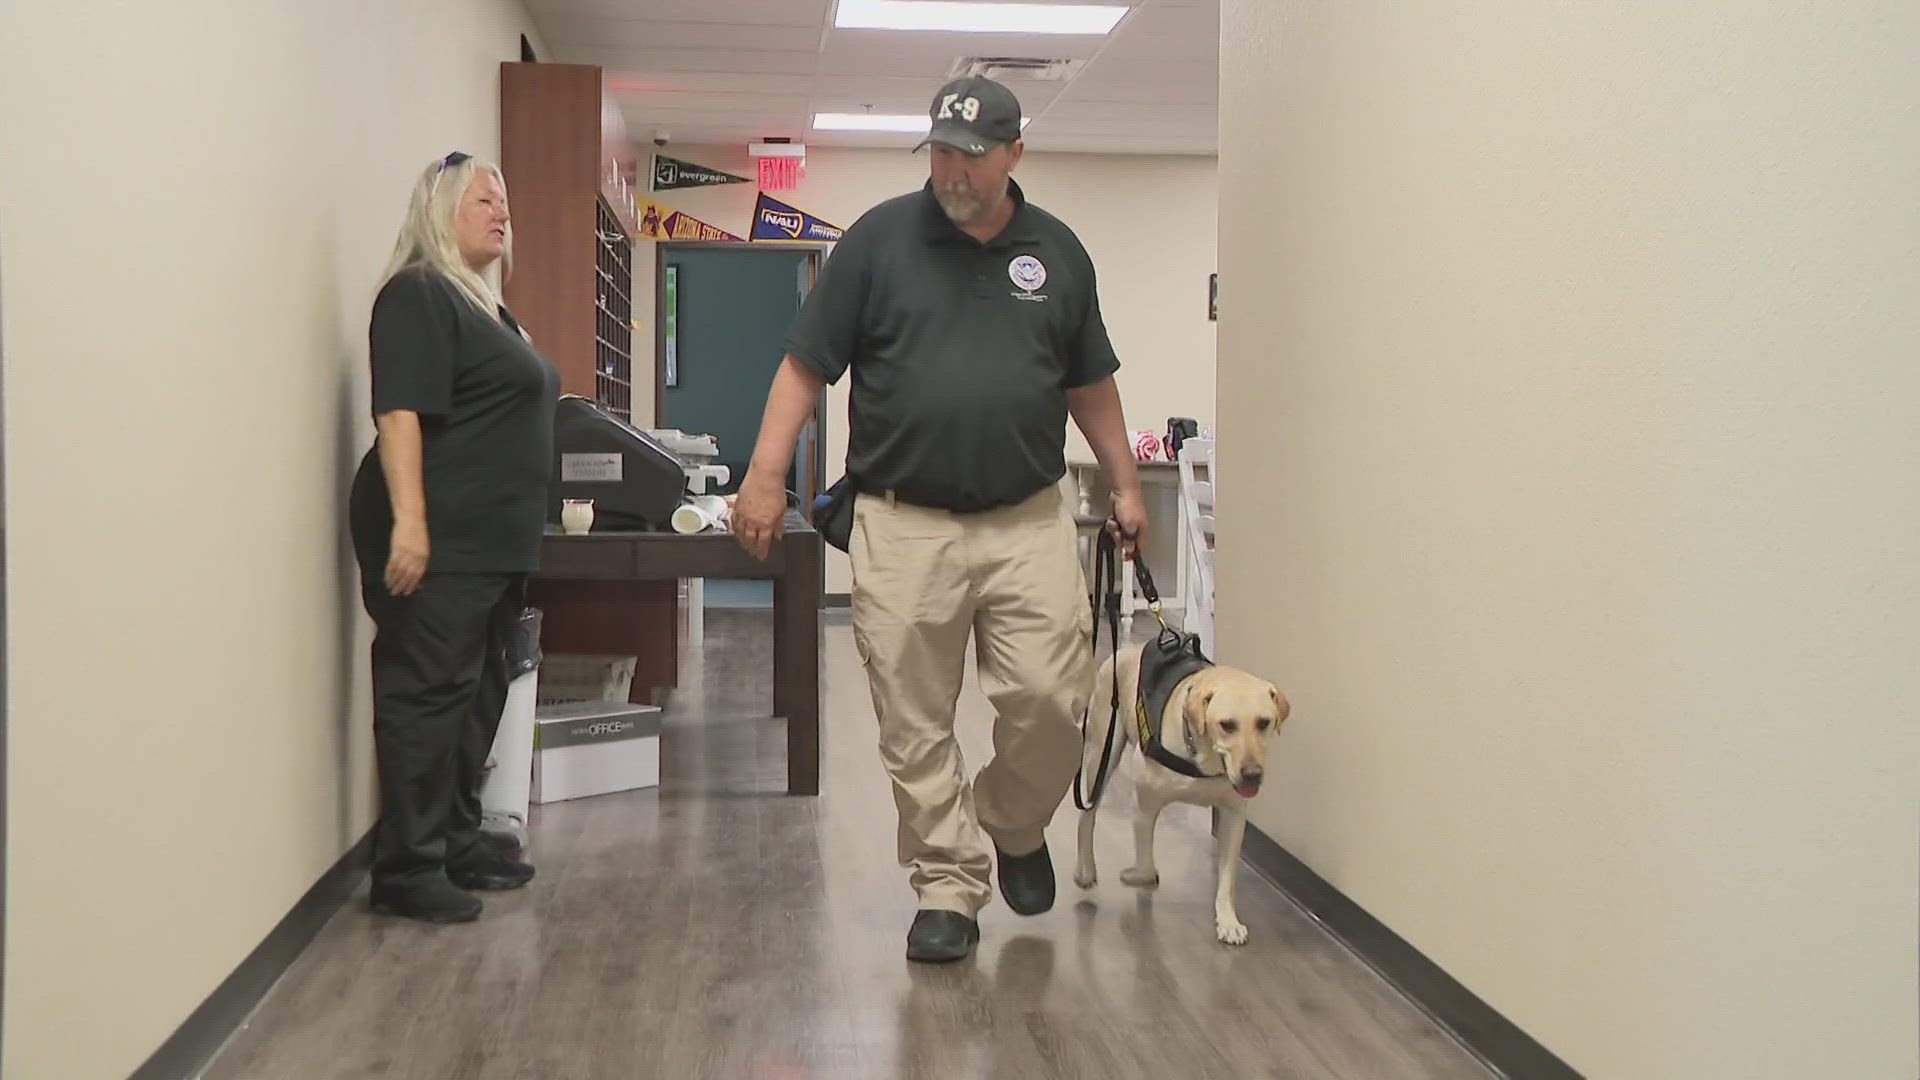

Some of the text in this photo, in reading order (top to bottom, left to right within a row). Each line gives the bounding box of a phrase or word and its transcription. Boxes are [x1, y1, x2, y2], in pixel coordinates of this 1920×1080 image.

[937, 93, 980, 122] K-9
[680, 170, 727, 182] evergreen
[759, 158, 798, 190] EXIT
[765, 213, 798, 229] NAU
[588, 721, 622, 736] OFFICE
